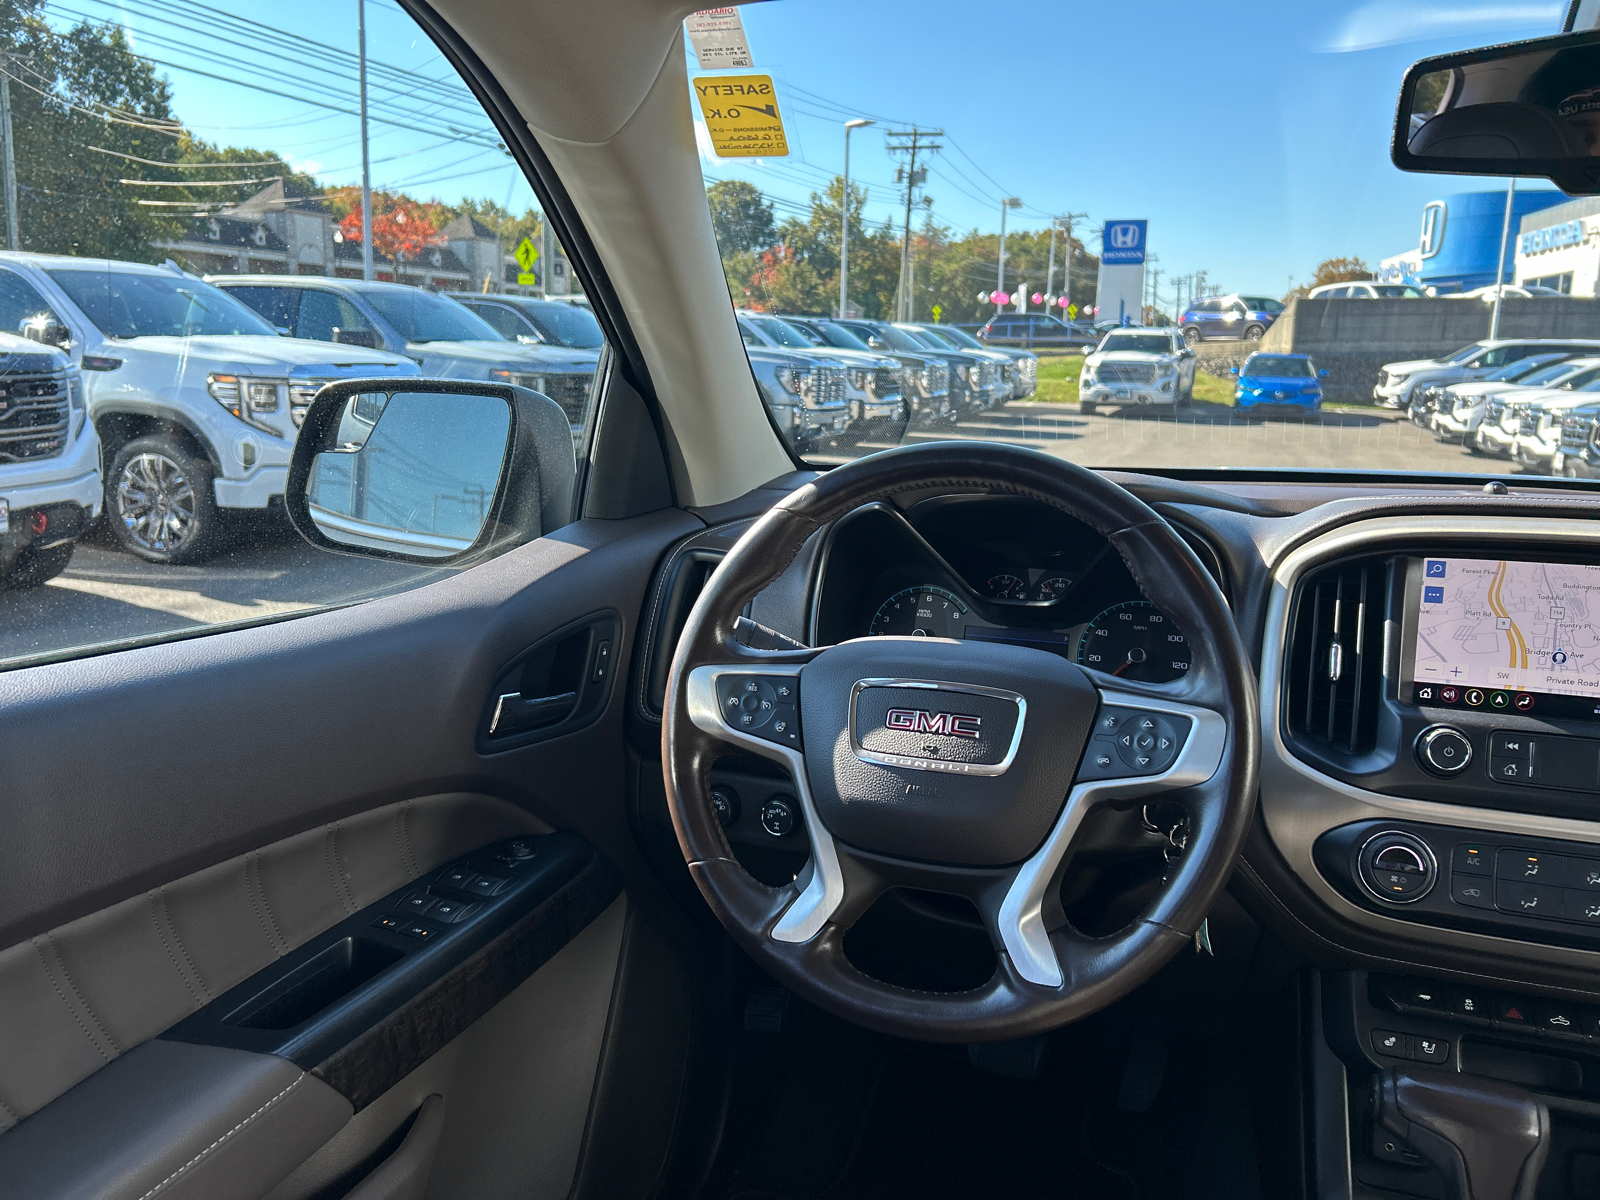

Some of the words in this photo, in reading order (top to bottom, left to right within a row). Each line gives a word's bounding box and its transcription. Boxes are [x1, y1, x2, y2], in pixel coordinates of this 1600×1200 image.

[1520, 219, 1582, 254] HONDA
[1103, 250, 1143, 258] HONDA
[1119, 613, 1132, 621] 60
[1149, 615, 1163, 623] 80
[1095, 629, 1108, 637] 40
[1172, 662, 1188, 670] 120
[1546, 676, 1575, 685] Private
[1577, 679, 1599, 687] Road
[886, 709, 981, 738] GMC
[884, 756, 969, 772] DENALI
[1467, 857, 1480, 866] A/C
